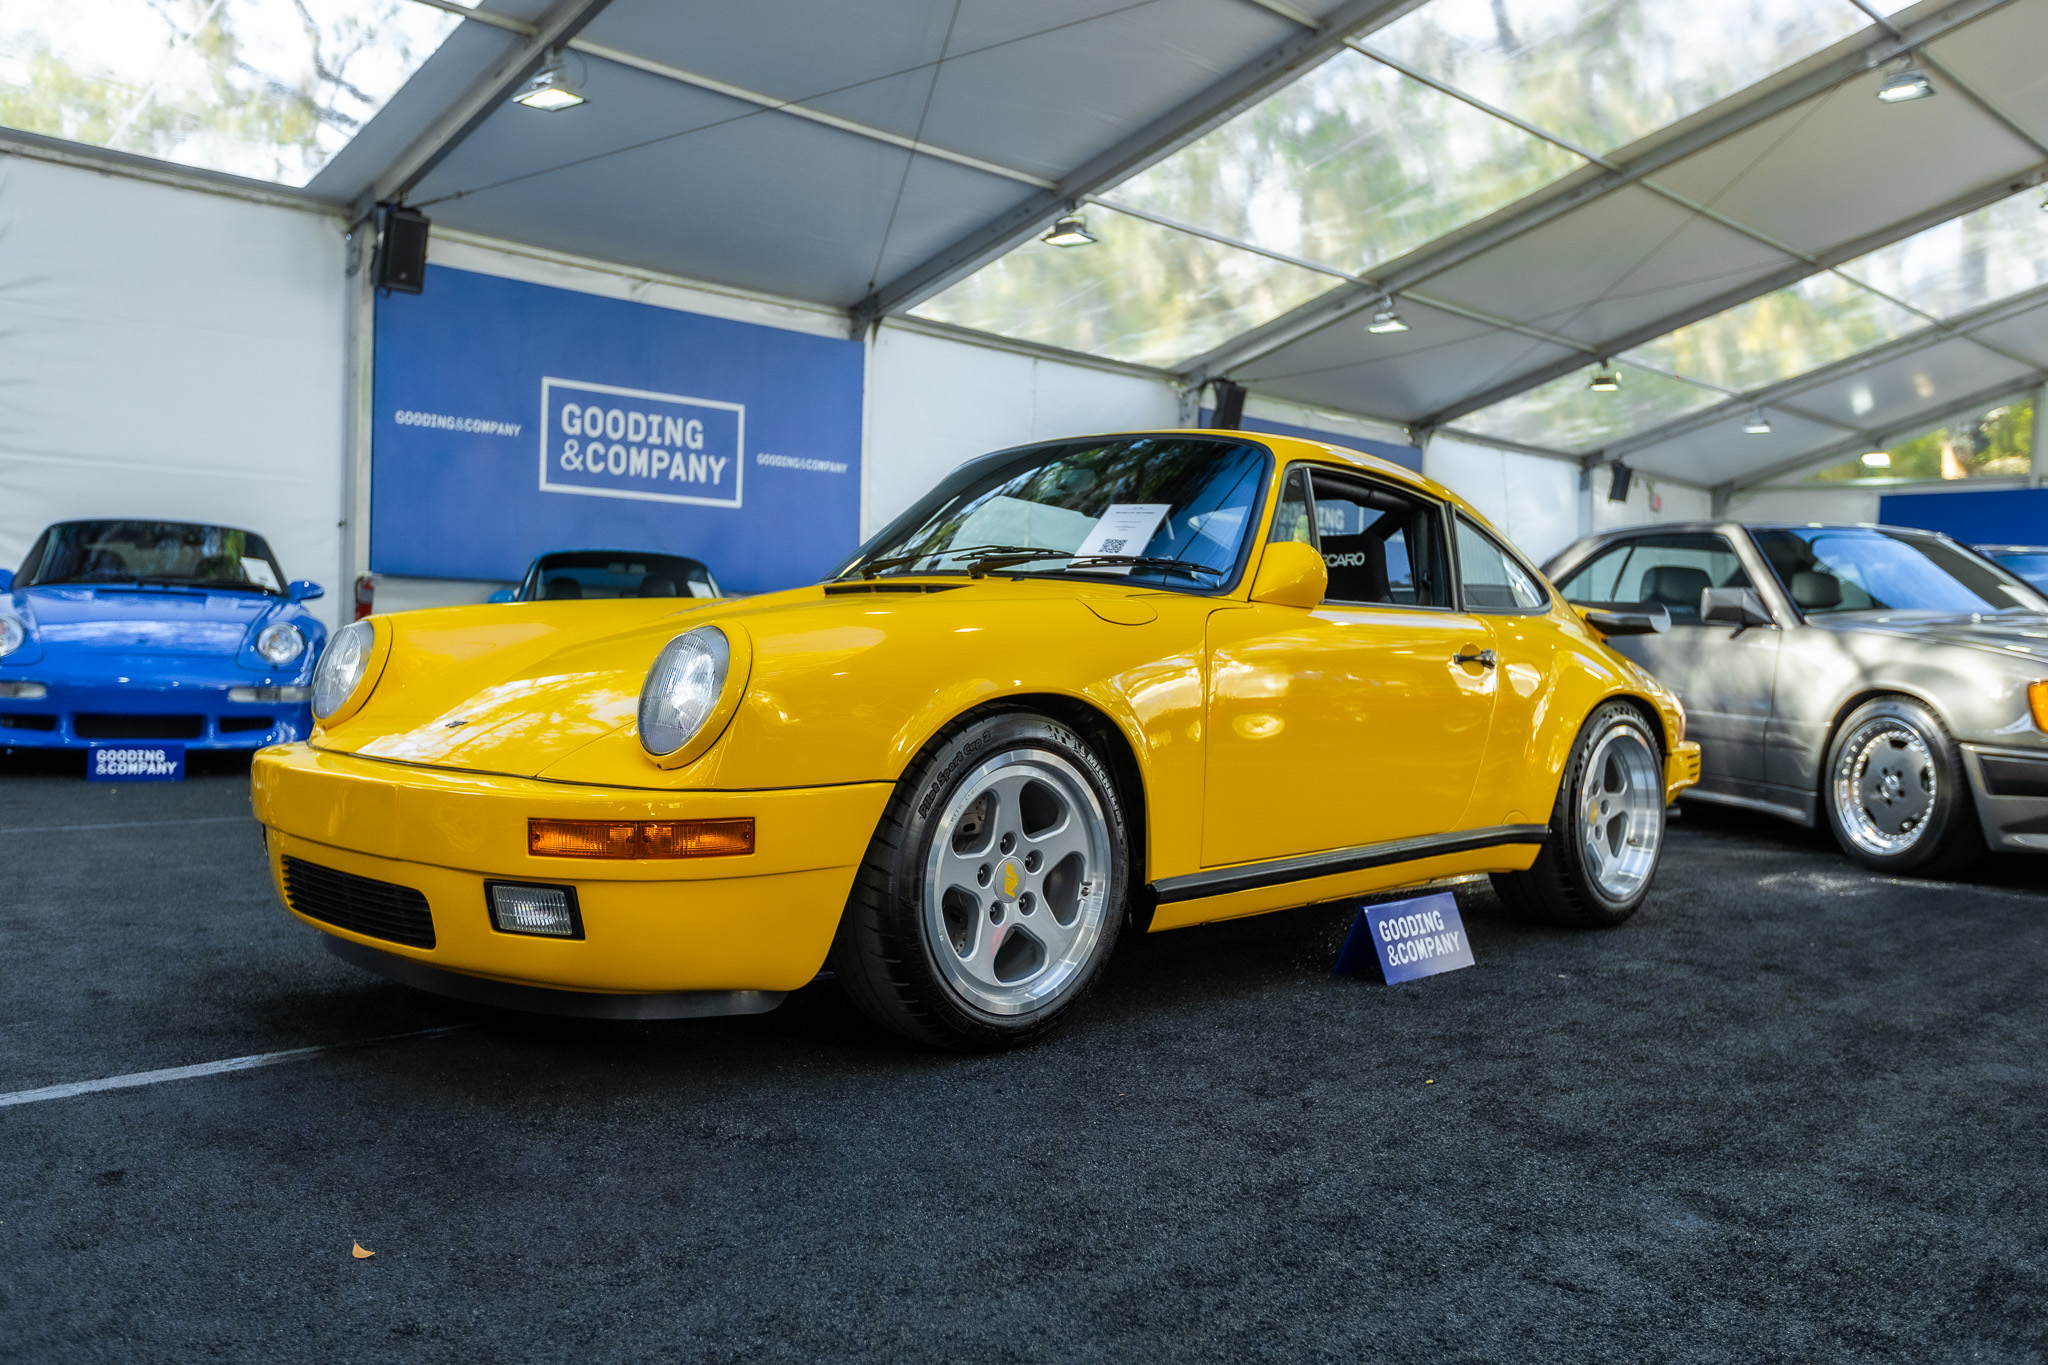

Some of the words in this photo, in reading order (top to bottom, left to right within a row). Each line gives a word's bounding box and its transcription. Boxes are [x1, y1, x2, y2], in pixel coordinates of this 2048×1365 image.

[394, 409, 522, 437] GOODING&COMPANY
[561, 402, 704, 451] GOODING
[560, 438, 727, 486] &COMPANY
[95, 761, 178, 775] &COMPANY
[96, 749, 166, 763] GOODING
[918, 782, 941, 819] Pilot
[936, 751, 965, 787] Sport
[963, 738, 983, 756] Cup
[982, 730, 992, 744] 2
[1378, 910, 1445, 943] GOODING
[1386, 931, 1461, 967] &COMPANY
